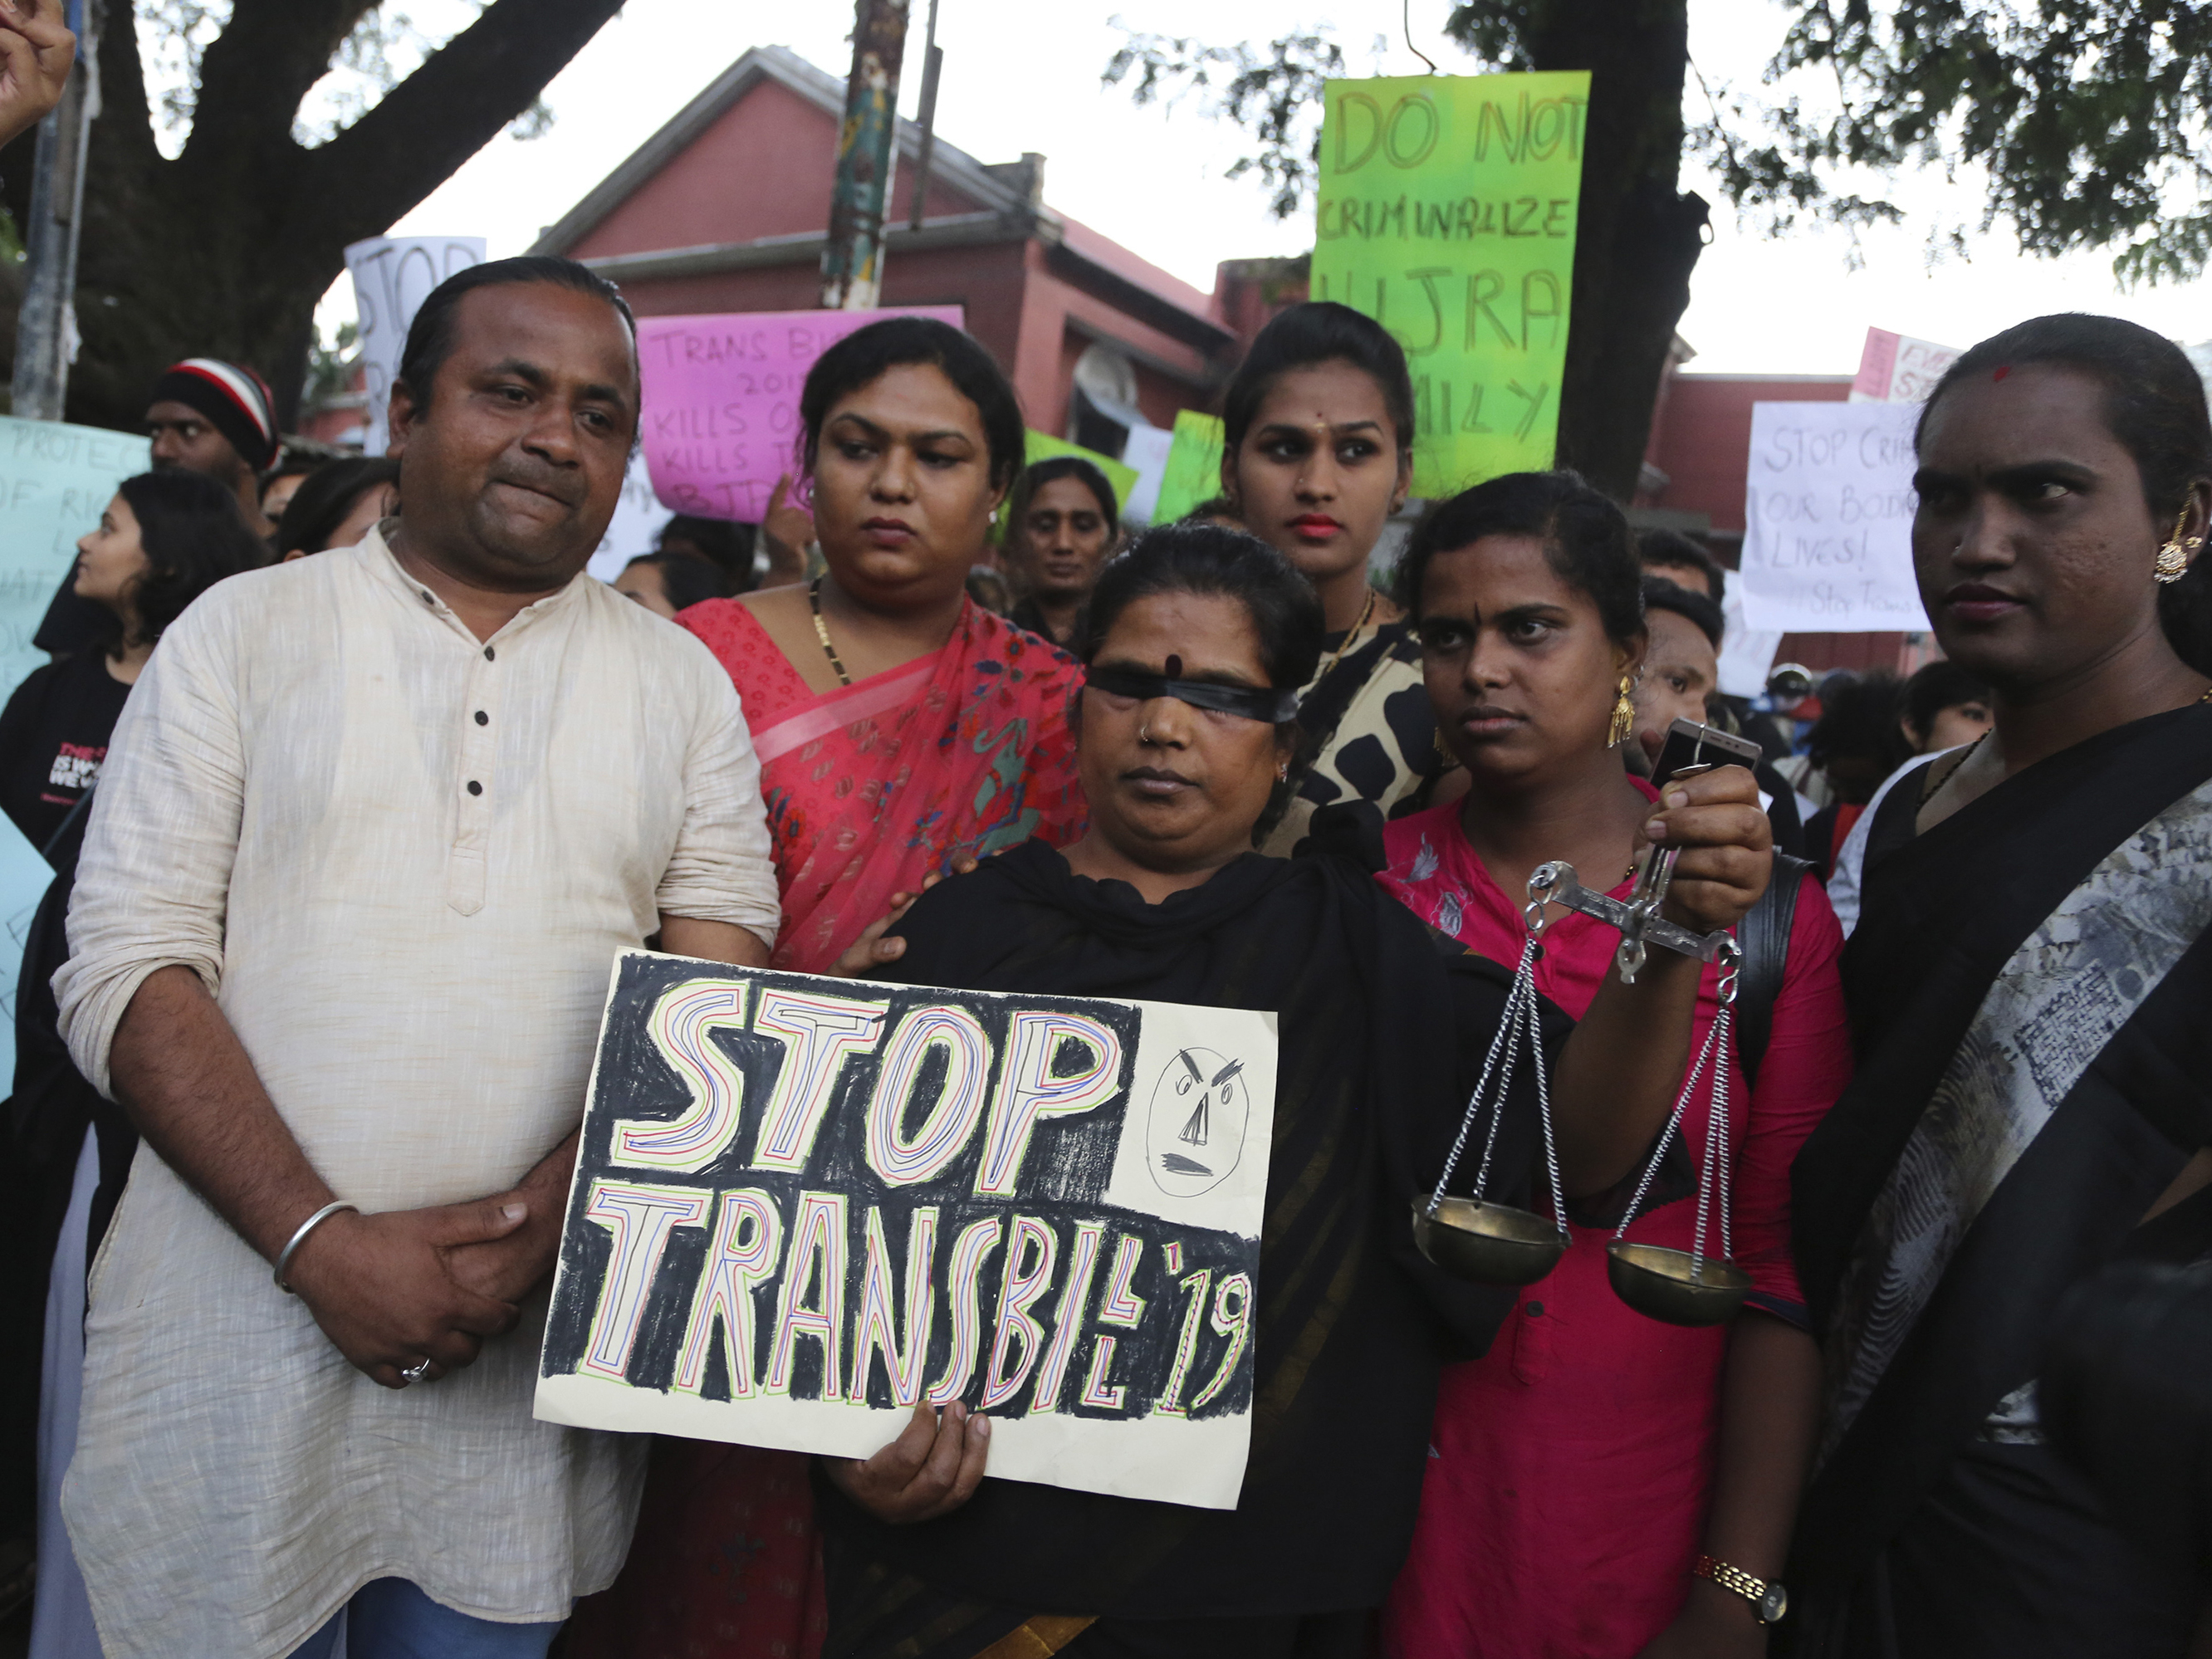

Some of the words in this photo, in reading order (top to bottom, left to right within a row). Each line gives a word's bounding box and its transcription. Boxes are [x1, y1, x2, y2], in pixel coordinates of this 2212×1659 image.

[1334, 91, 1440, 175] DO
[1475, 91, 1588, 164] NOT
[648, 330, 768, 368] TRANS
[737, 371, 805, 396] 201
[653, 401, 748, 440] KILLS
[662, 442, 750, 474] KILLS
[1764, 424, 1848, 474] STOP
[1765, 490, 1823, 525] OUR
[1769, 527, 1869, 573] LIVES!
[611, 978, 1123, 1196] STOP
